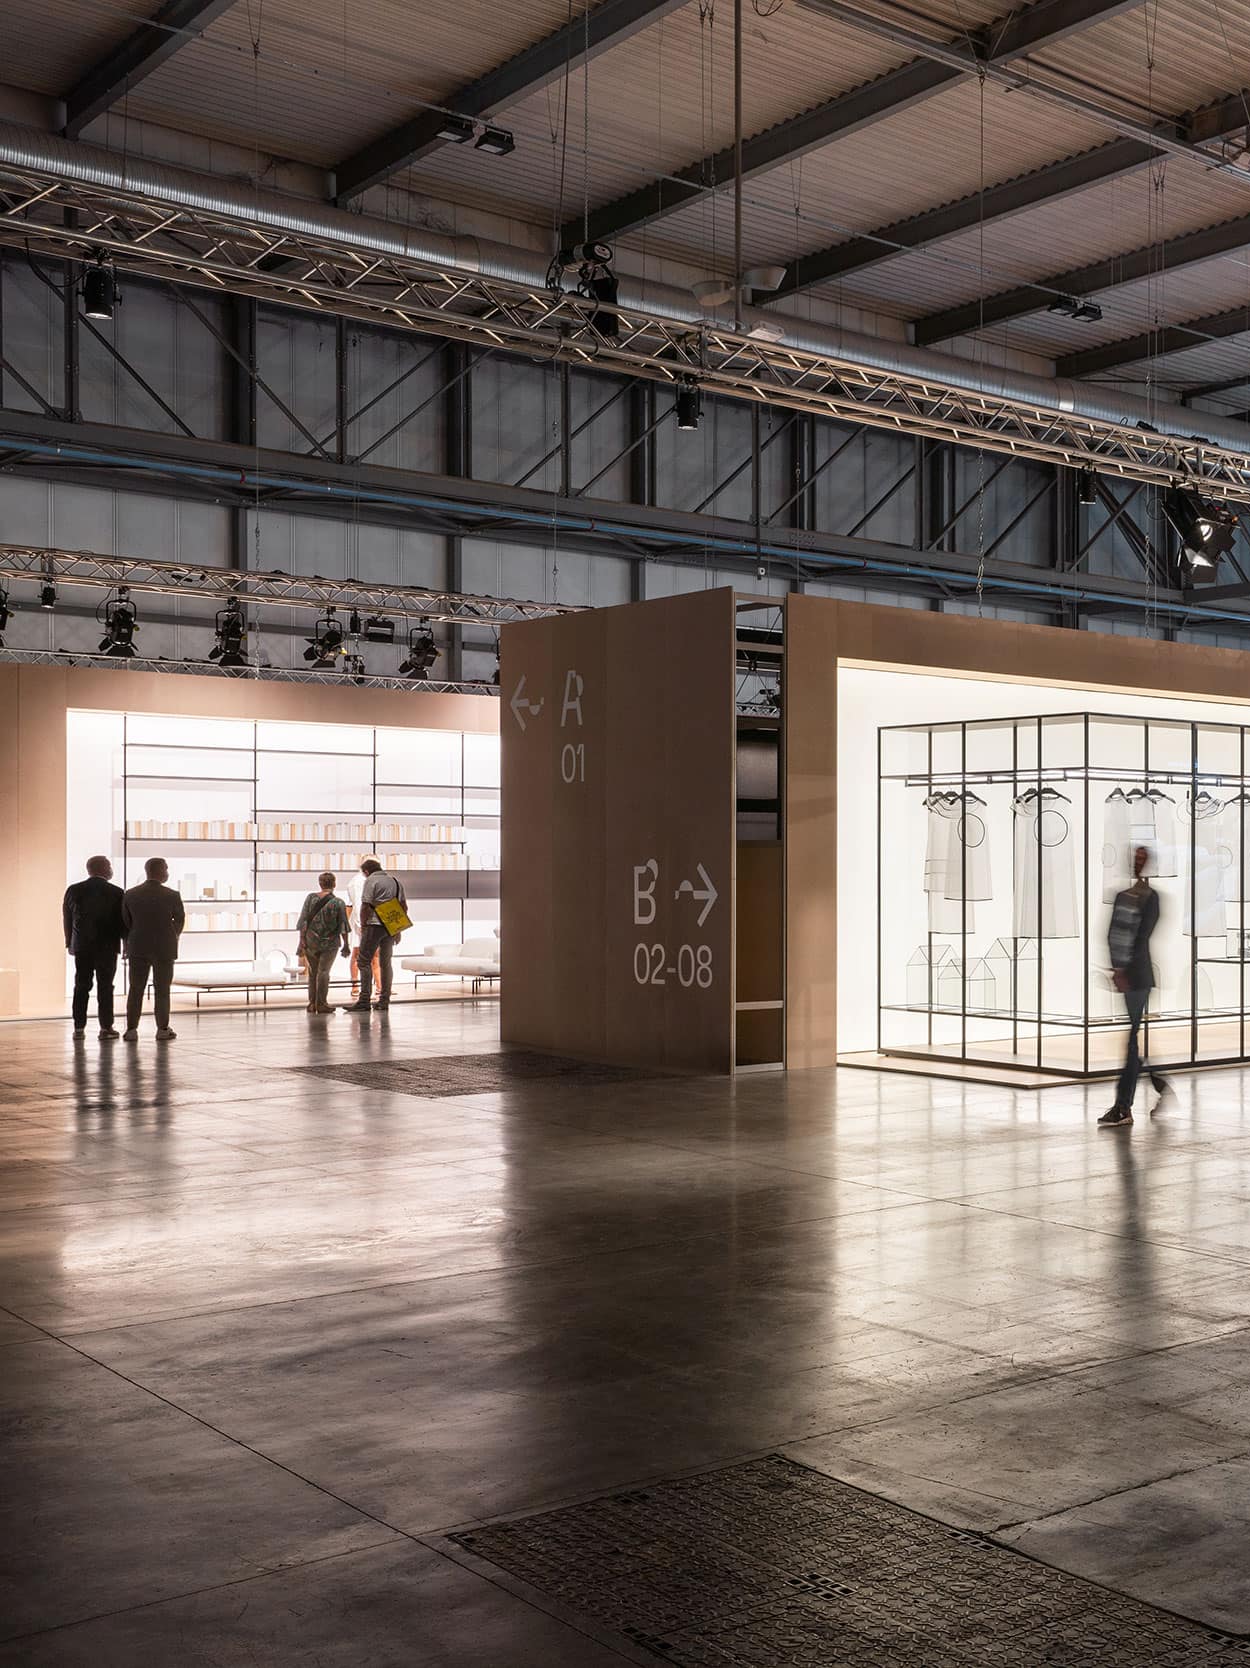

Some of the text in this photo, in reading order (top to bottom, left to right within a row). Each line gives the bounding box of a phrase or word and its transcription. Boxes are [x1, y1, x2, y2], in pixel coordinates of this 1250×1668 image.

[560, 670, 584, 728] A
[561, 743, 585, 784] 01
[633, 858, 659, 926] B
[633, 942, 713, 989] 02-08
